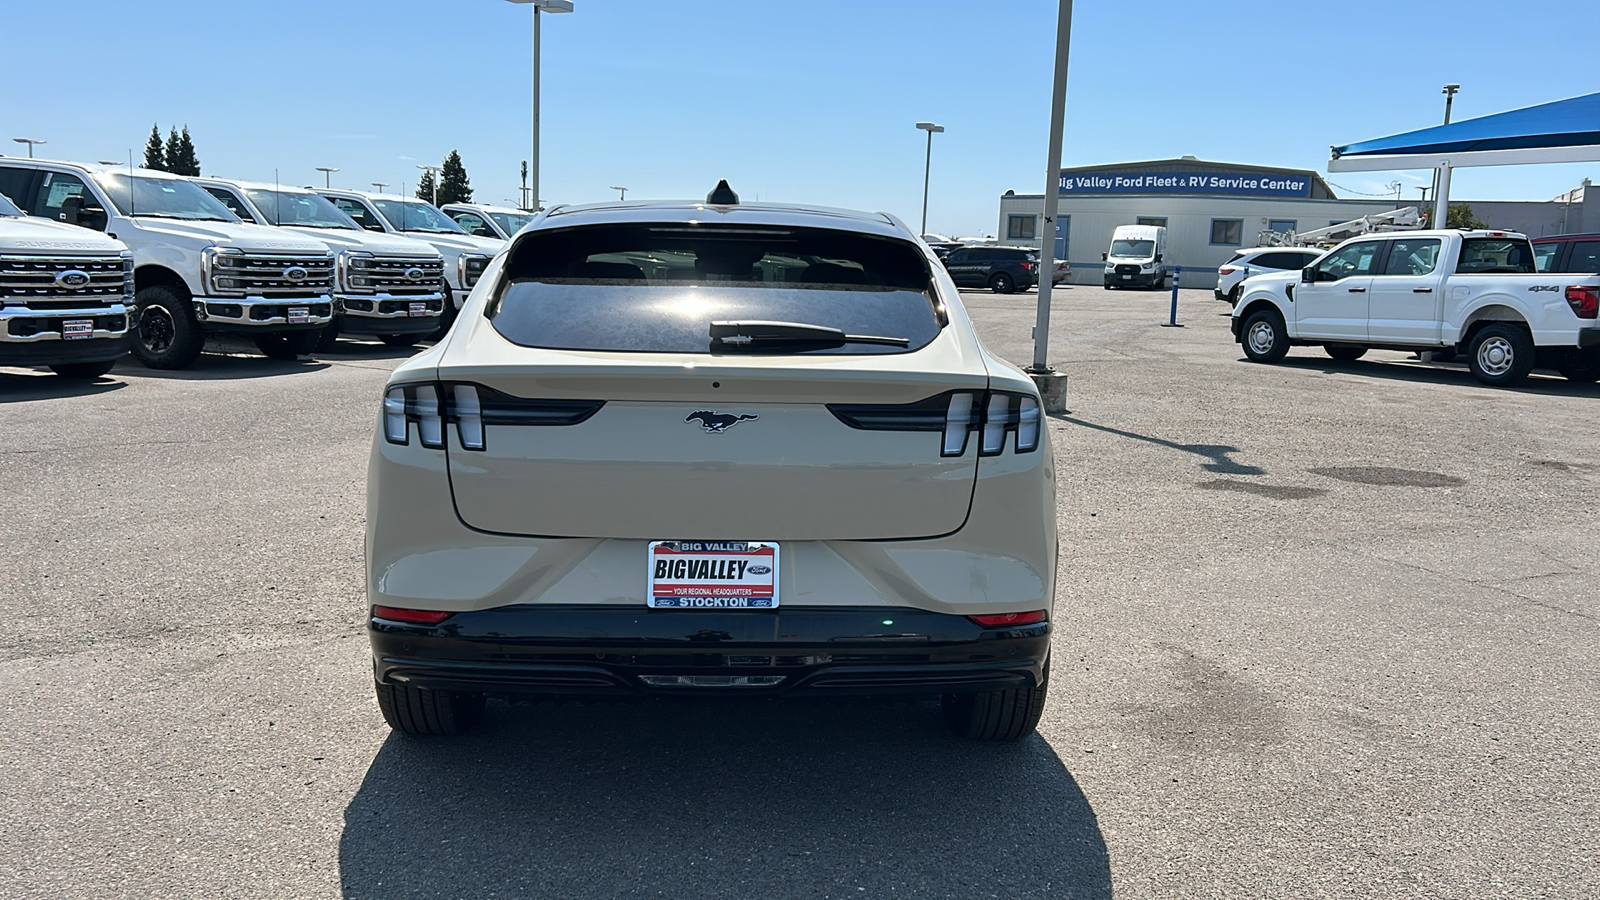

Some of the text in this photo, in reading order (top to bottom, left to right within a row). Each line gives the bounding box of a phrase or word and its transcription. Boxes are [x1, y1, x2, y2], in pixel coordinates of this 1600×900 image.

[1076, 176, 1113, 189] Valley
[1115, 176, 1143, 187] Ford
[1145, 176, 1177, 187] Fleet
[1179, 178, 1187, 187] &
[1189, 176, 1208, 187] RV
[1209, 177, 1258, 189] Service
[1260, 178, 1305, 191] Center
[66, 275, 84, 285] Ford
[681, 543, 747, 551] BIG VALLEY
[654, 559, 749, 580] BIGVALLEY
[749, 565, 770, 575] Ford
[713, 588, 752, 596] HEADQUARTERS
[679, 597, 748, 607] STOCKTON
